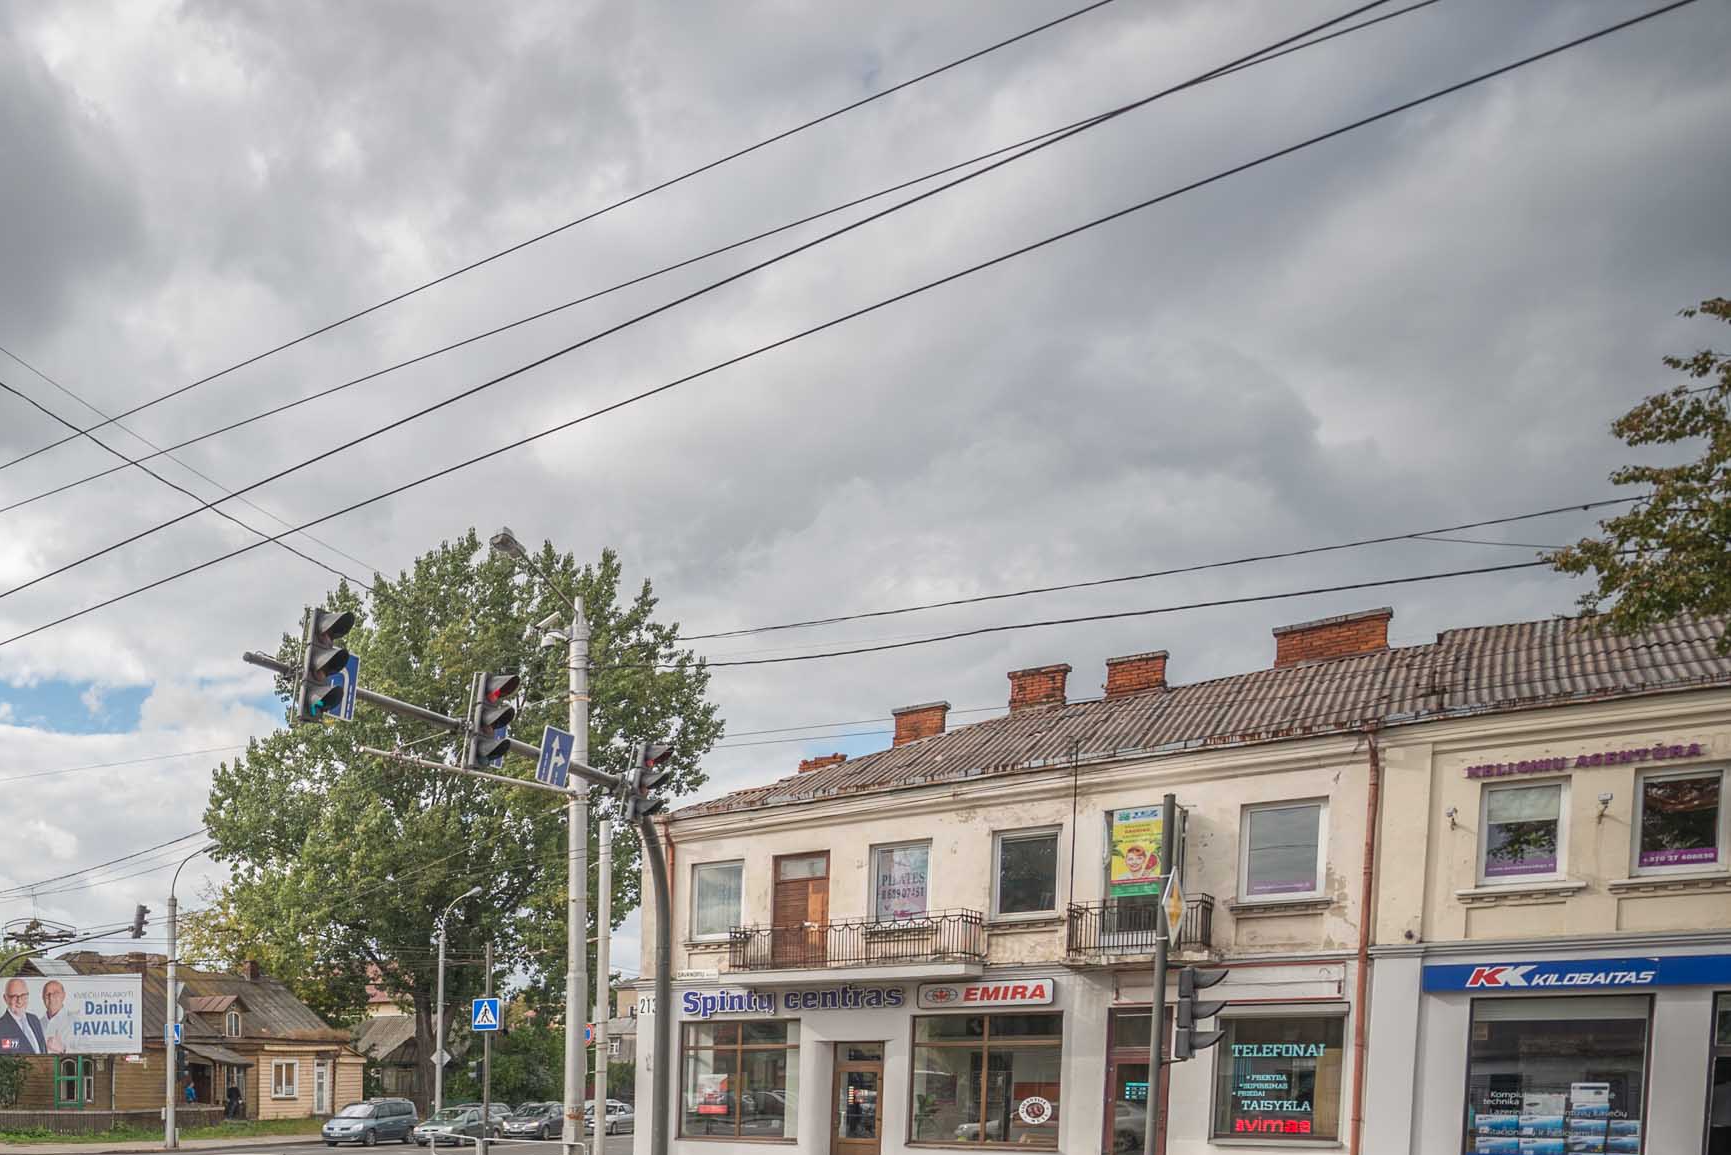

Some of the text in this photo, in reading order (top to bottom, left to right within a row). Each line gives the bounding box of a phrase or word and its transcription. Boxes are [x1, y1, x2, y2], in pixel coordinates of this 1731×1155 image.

[1531, 970, 1656, 986] KILOBAITAS
[683, 983, 905, 1018] Spintų centras
[963, 984, 1046, 1002] EMIRA
[85, 1000, 133, 1019] Dainių
[73, 1020, 134, 1039] PAVALKĮ
[1231, 1044, 1327, 1057] TELEFONAI
[1241, 1100, 1311, 1111] TAISYKLA
[1483, 1097, 1520, 1105] technika
